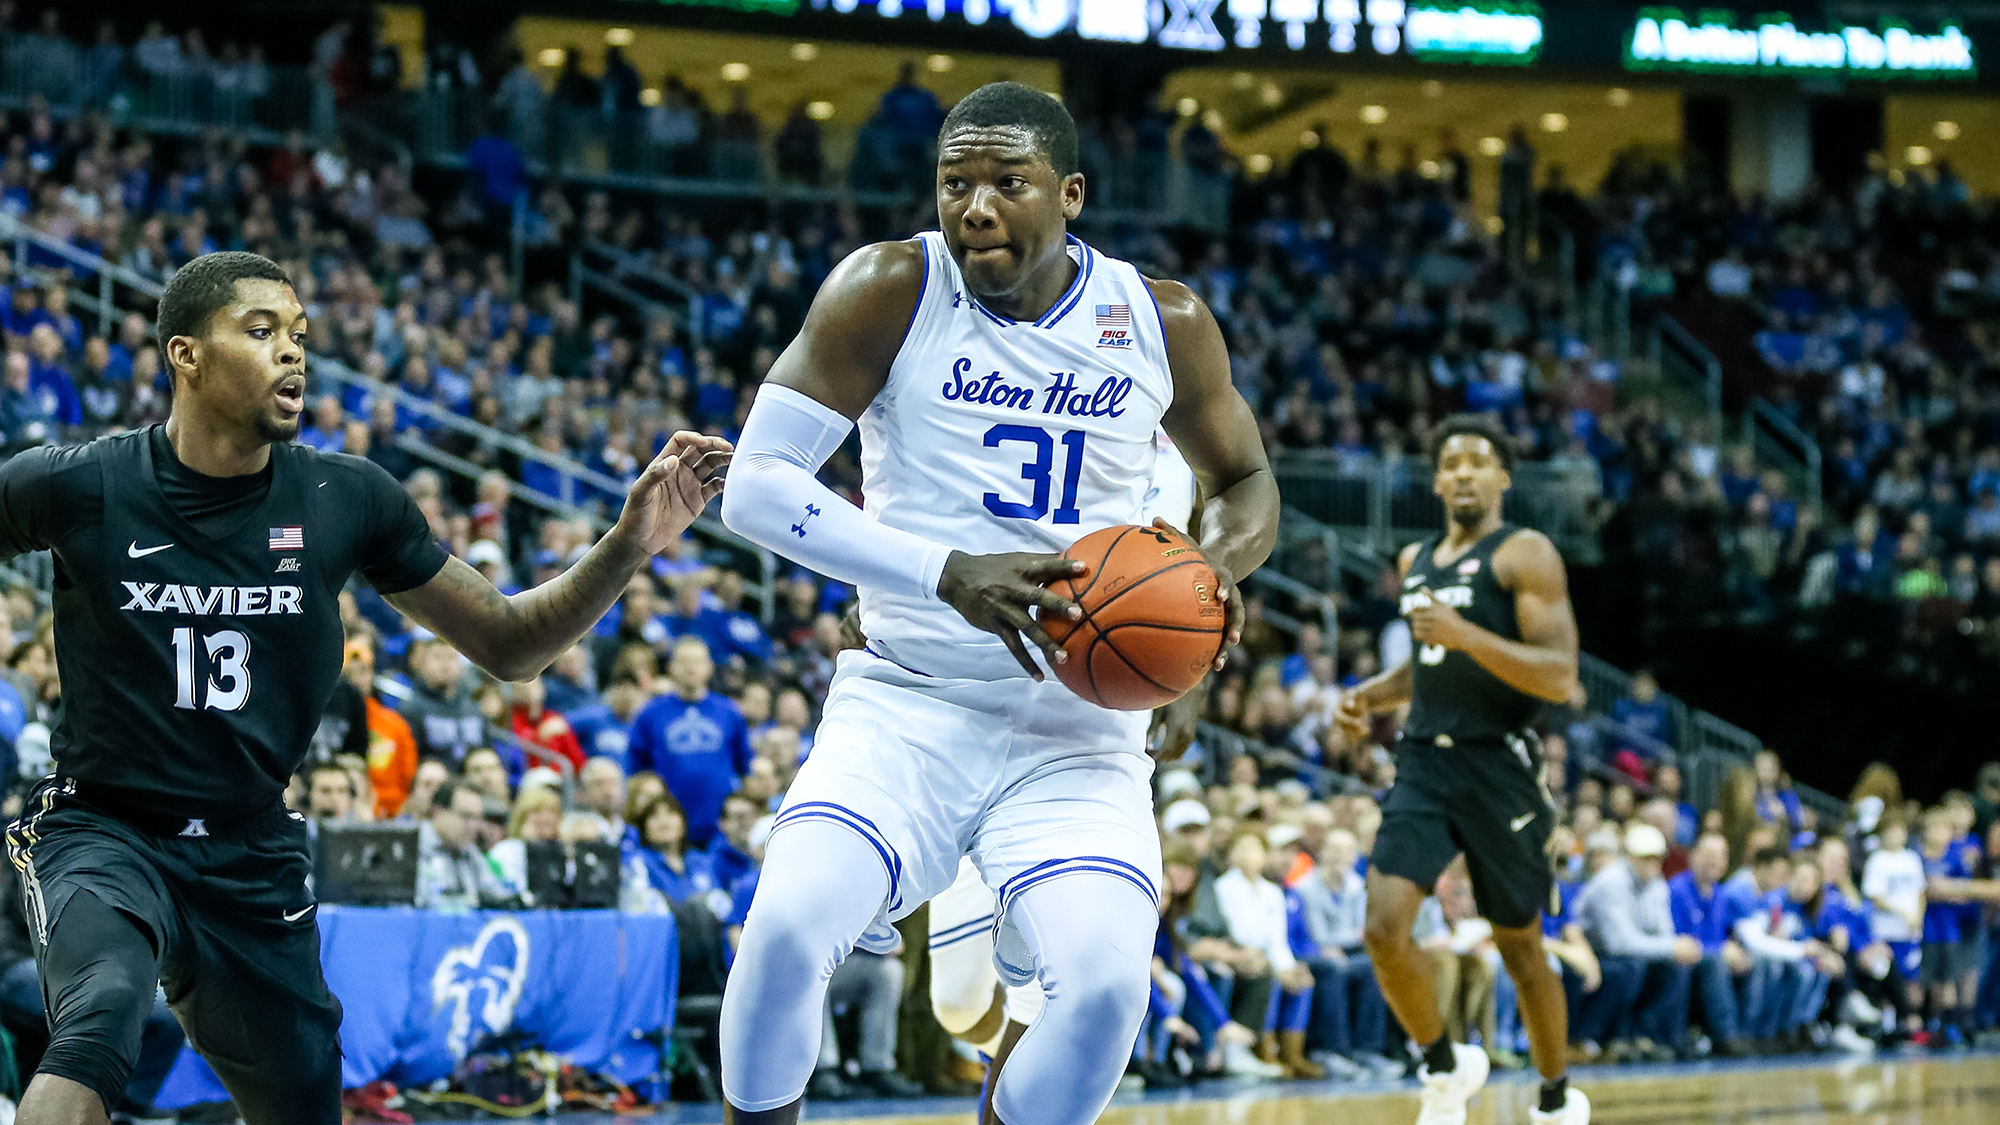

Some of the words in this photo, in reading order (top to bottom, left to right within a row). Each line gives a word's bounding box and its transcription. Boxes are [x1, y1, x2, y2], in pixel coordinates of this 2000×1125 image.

[1632, 18, 1661, 60] A
[1098, 338, 1134, 346] EAST
[1102, 330, 1127, 338] BIG
[942, 357, 1033, 411] Seton
[1042, 371, 1133, 418] Hall
[983, 423, 1086, 525] 31
[120, 580, 303, 616] XAVIER
[171, 626, 251, 711] 13
